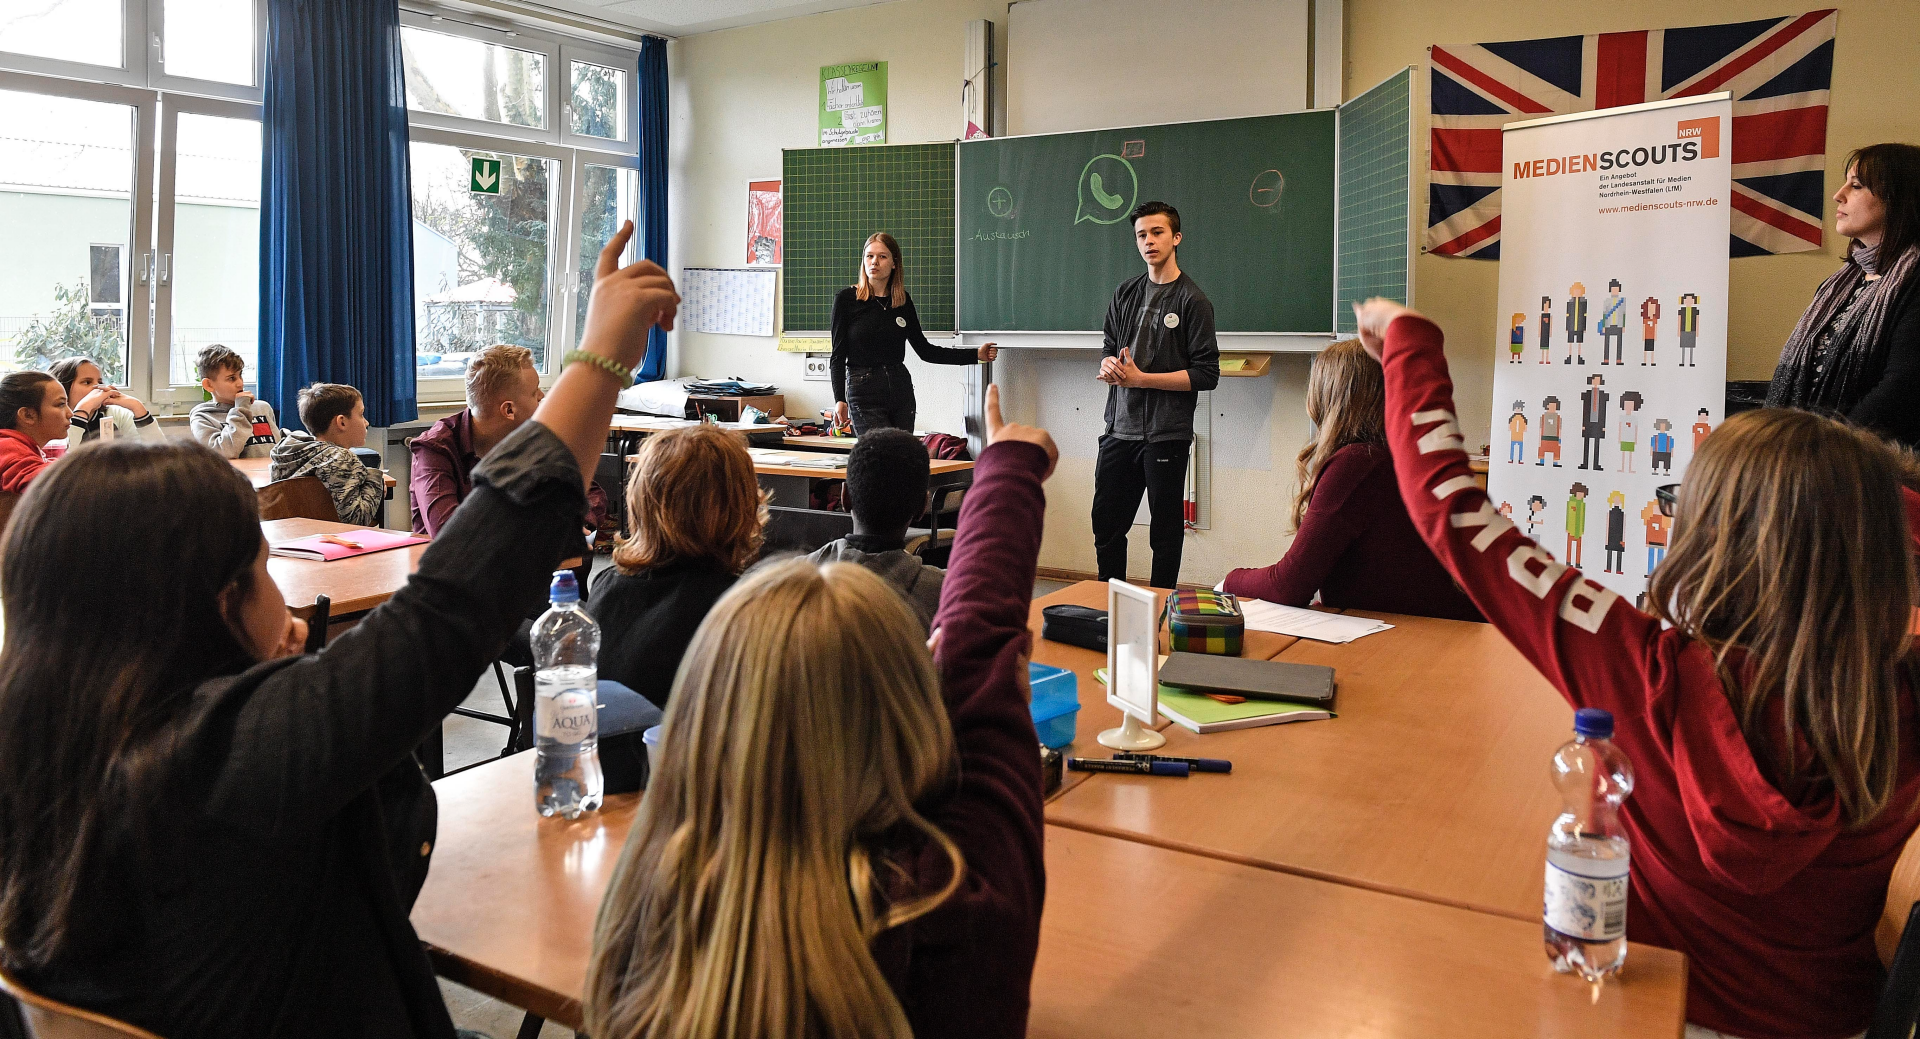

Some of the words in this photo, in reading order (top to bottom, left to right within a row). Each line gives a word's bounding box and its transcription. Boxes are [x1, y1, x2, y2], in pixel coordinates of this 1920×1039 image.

[1679, 128, 1702, 137] NRW
[1514, 142, 1698, 180] MEDIENSCOUTS
[1611, 172, 1637, 181] Angebot
[1611, 179, 1655, 189] Landesanstalt
[1667, 175, 1692, 183] Medien
[1599, 186, 1664, 198] Nordrhein-Westfalen
[1665, 185, 1682, 194] (LfM)
[1599, 197, 1718, 214] www.medienscouts-nrw.de
[552, 715, 590, 730] AQUA
